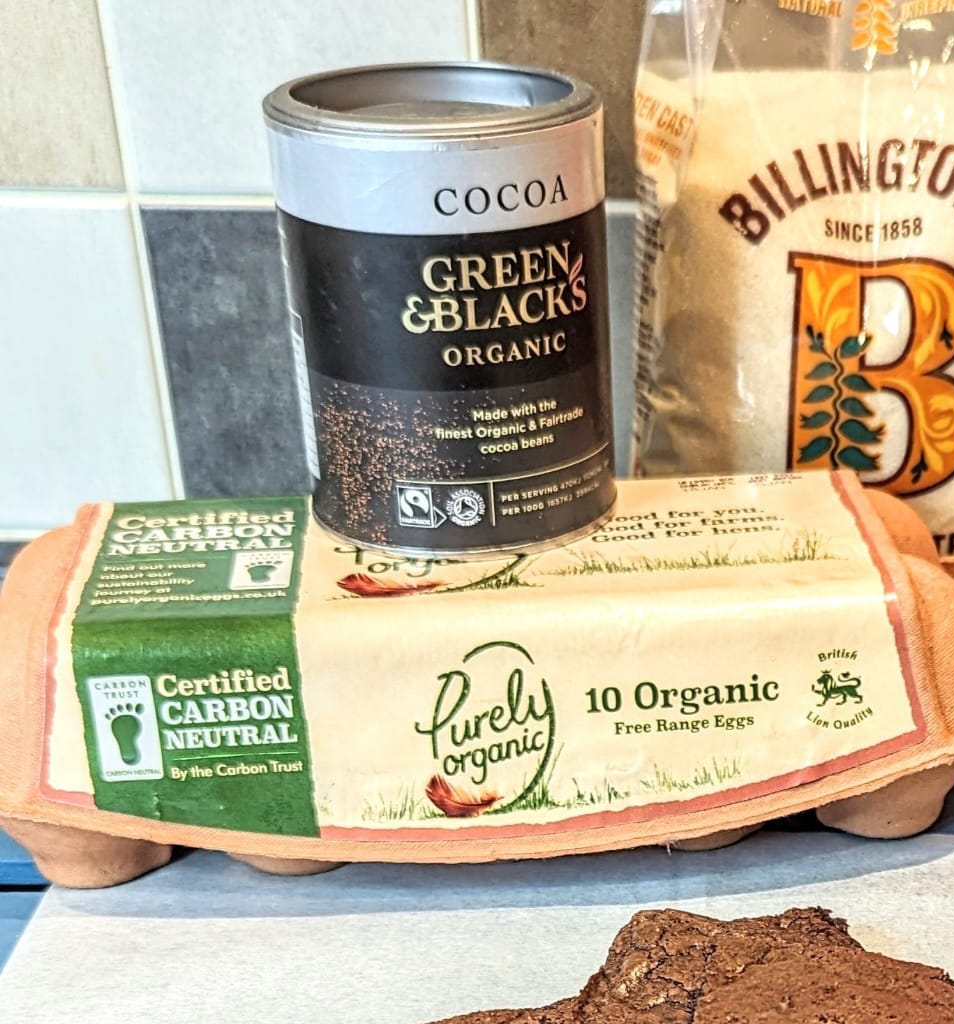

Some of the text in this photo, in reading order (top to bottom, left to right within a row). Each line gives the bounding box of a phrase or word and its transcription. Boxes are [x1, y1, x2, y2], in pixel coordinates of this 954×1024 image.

[434, 174, 568, 216] COCOA
[824, 217, 923, 242] SINCE 1858
[422, 241, 571, 293] GREEN
[443, 331, 566, 367] ORGANIC
[474, 399, 557, 421] Made with the
[436, 407, 583, 440] finest Organic & Fairtrade
[480, 434, 554, 455] cocoa beans
[501, 494, 519, 502] PER
[521, 485, 558, 499] SERVING
[117, 509, 295, 529] Certified
[502, 507, 520, 516] PER
[606, 506, 764, 524] ood for you.
[112, 524, 295, 544] CARBON
[591, 524, 781, 543] Good for hens.
[597, 516, 785, 533] ood for farms.
[107, 538, 292, 556] NEUTRAL
[100, 571, 175, 580] about our
[104, 562, 206, 572] Find out more
[93, 586, 171, 598] journey at
[97, 578, 195, 588] sustainability
[817, 649, 858, 663] British
[95, 680, 146, 690] CARBON
[156, 667, 292, 698] Certified
[105, 690, 139, 699] TRUST
[585, 674, 779, 715] 10 Organic
[159, 694, 294, 726] CARBON
[414, 668, 555, 759] Purely
[806, 706, 873, 730] Lion Quality
[614, 714, 755, 735] Free Range Eggs
[161, 721, 298, 751] NEUTRAL
[443, 728, 545, 785] organic
[171, 760, 304, 781] By the Carbon Trust
